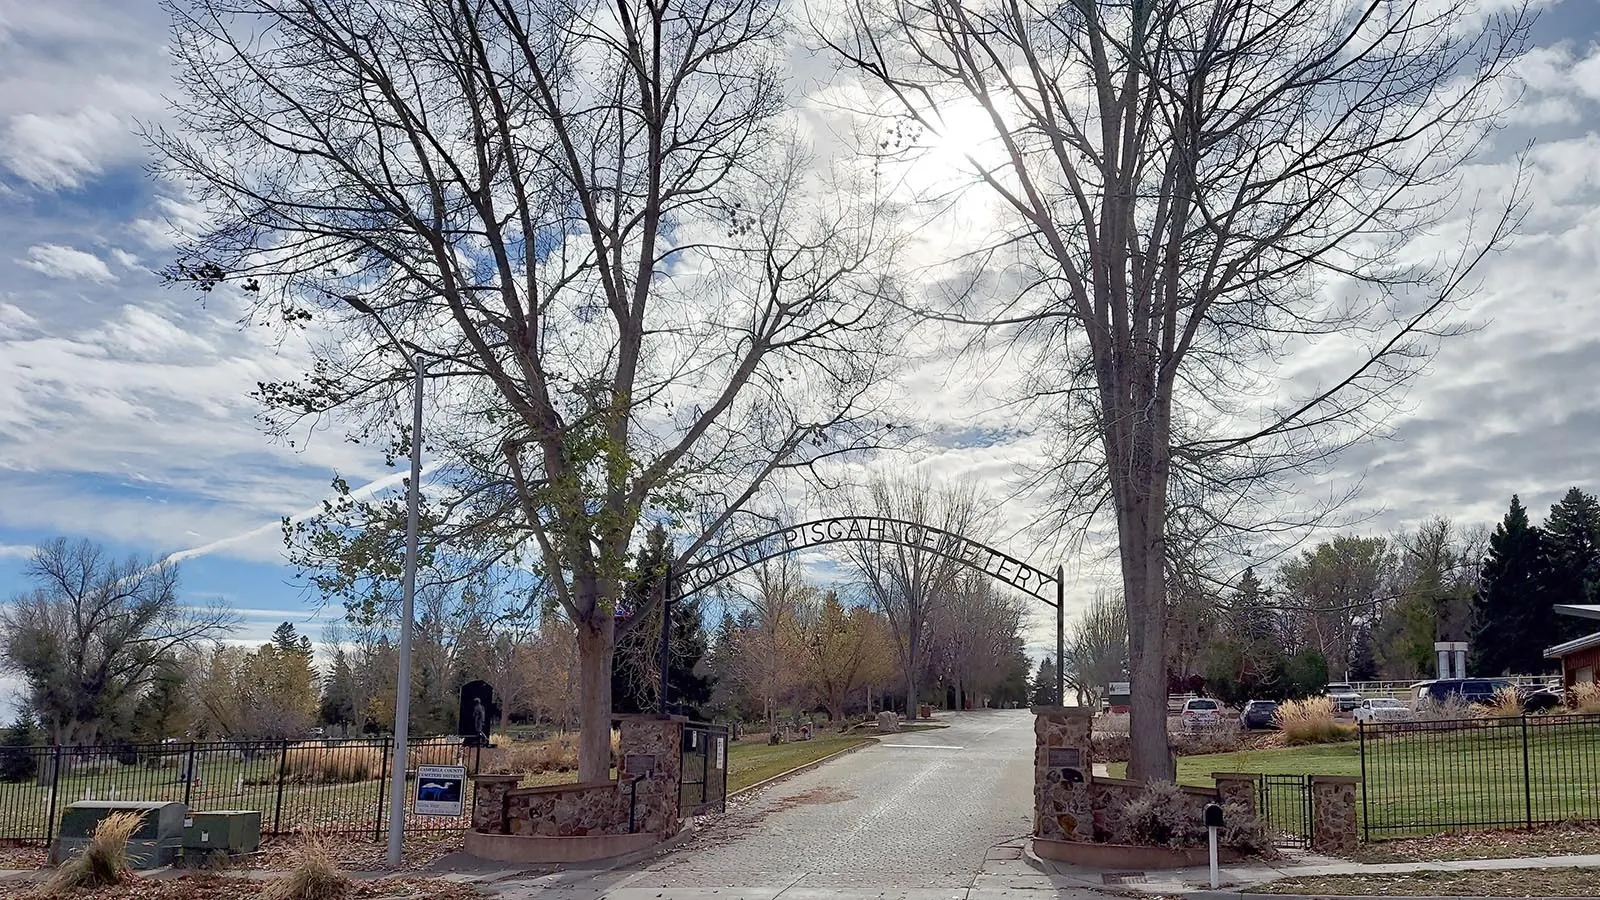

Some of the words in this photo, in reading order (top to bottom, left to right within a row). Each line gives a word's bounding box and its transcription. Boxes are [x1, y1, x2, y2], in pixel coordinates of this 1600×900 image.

[676, 540, 766, 596] MOUNT
[784, 519, 886, 550] PISGAH
[904, 525, 1054, 596] CEMETERY
